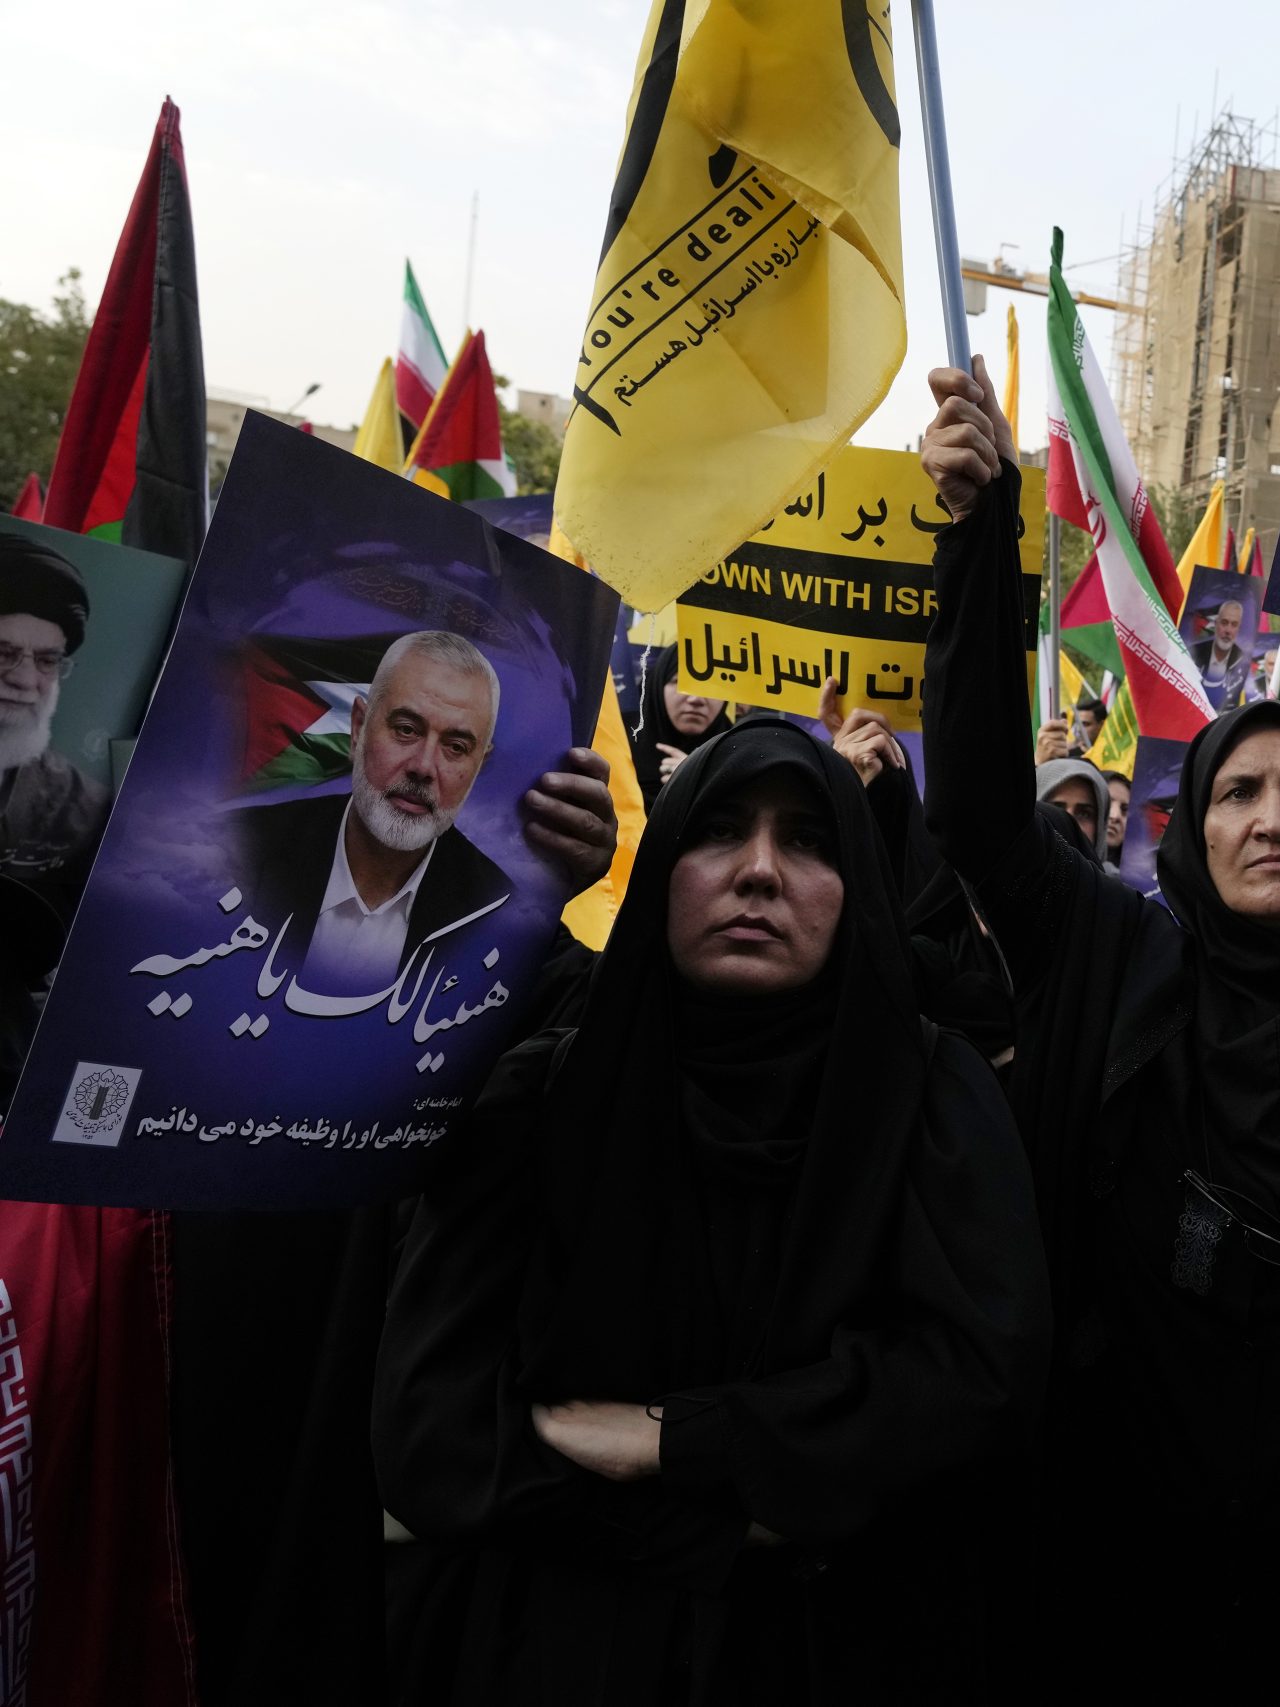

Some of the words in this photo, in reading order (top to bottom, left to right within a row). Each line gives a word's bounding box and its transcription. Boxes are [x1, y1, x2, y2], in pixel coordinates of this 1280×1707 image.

[687, 176, 776, 263] deali
[702, 560, 772, 596] OWN
[781, 570, 871, 611] WITH
[240, 1115, 283, 1145] خود
[286, 1117, 339, 1148] وظیفه
[342, 1119, 357, 1149] را
[359, 1121, 380, 1150] او
[374, 1120, 448, 1150] خونخواهی
